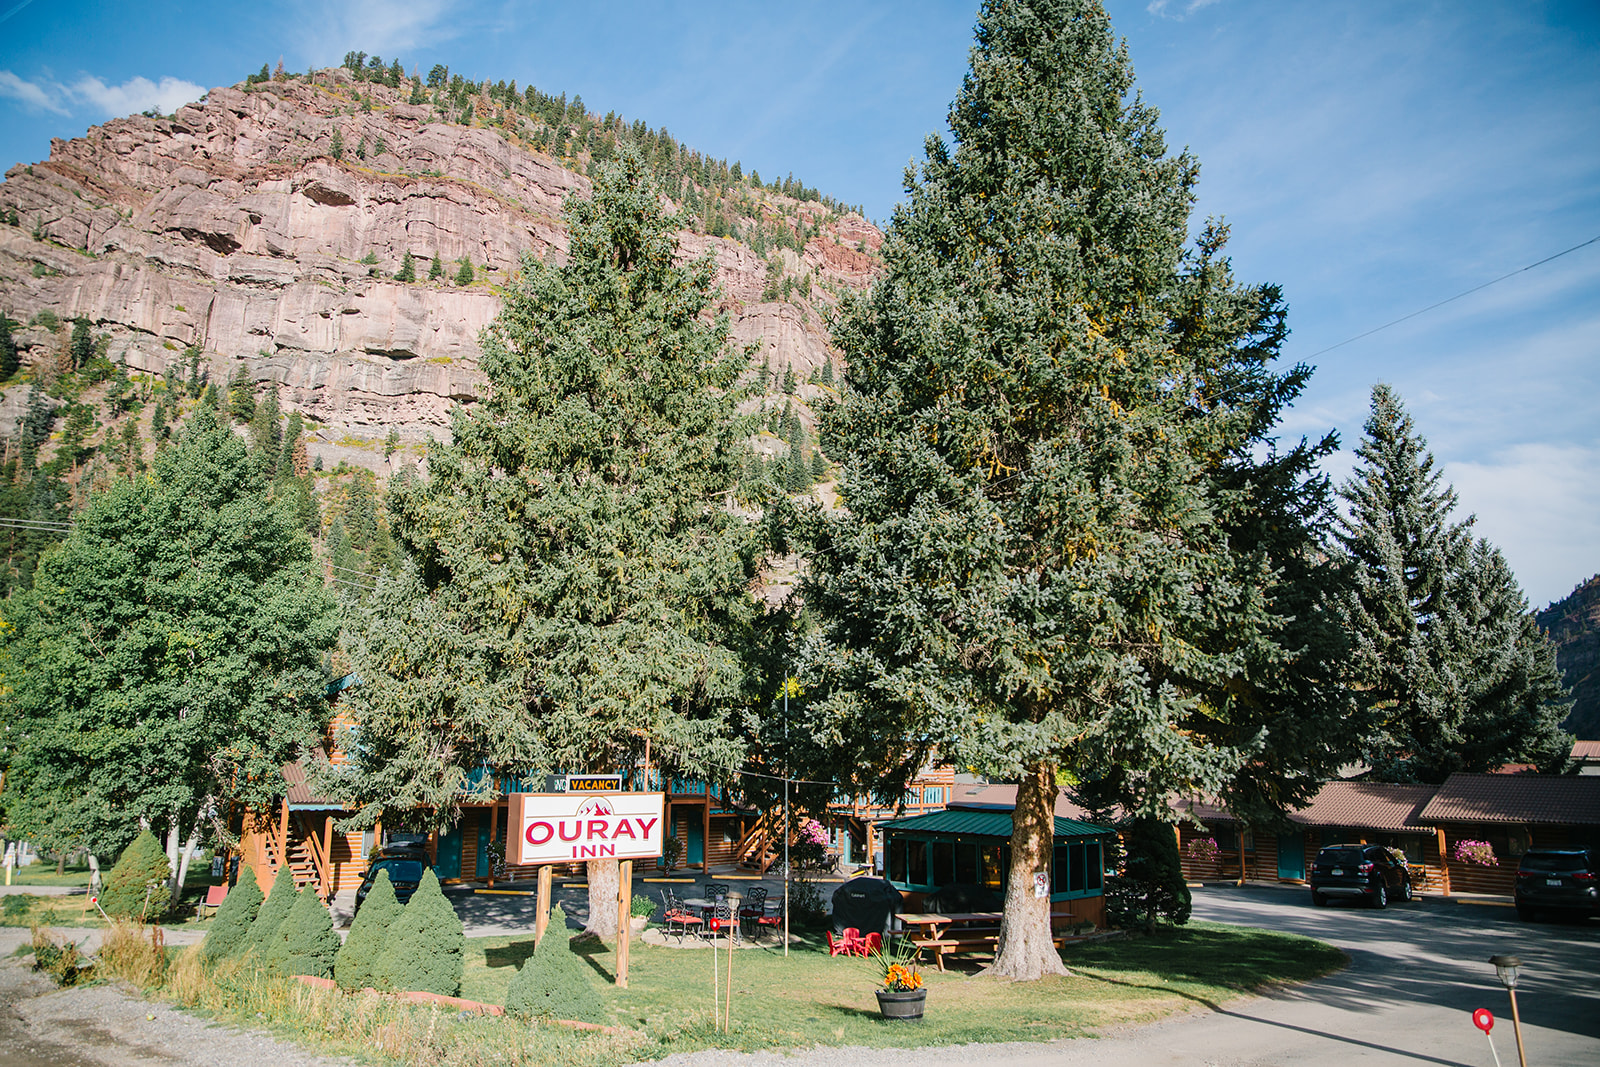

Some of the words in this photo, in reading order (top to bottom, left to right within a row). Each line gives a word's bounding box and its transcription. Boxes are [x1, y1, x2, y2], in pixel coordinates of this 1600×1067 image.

[571, 780, 618, 790] VACANCY
[525, 818, 658, 846] OURAY
[572, 844, 615, 859] INN
